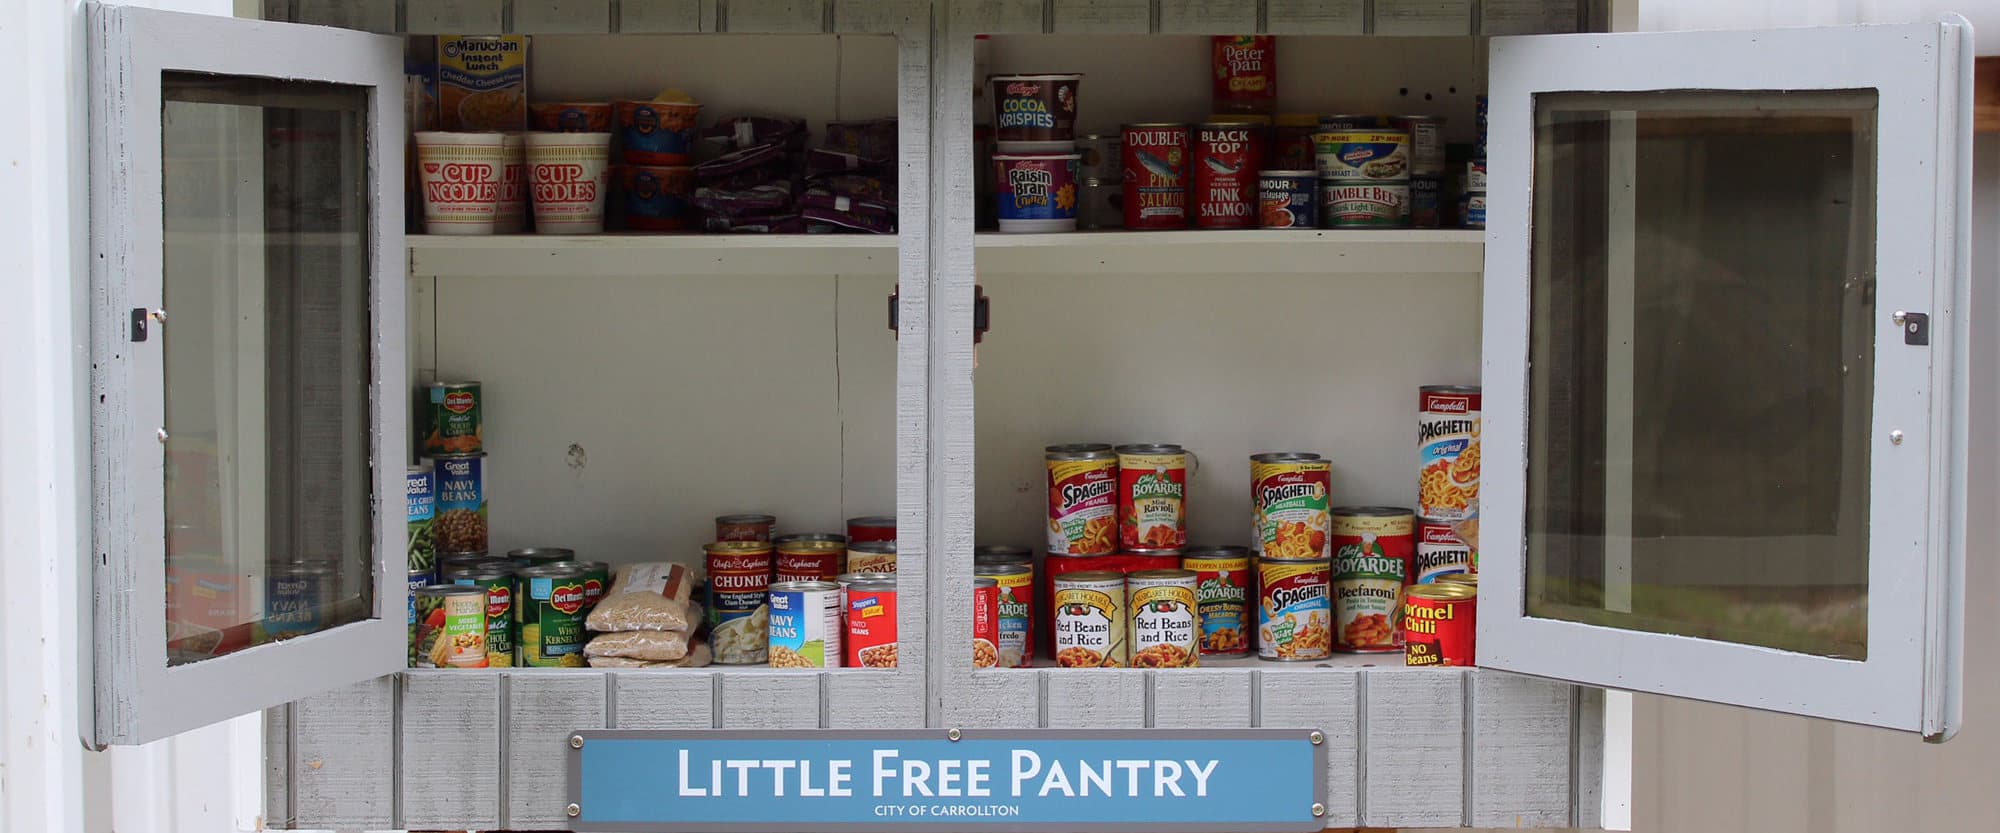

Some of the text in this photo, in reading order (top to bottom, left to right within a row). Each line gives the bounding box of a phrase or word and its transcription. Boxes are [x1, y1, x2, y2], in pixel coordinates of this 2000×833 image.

[457, 39, 518, 52] Maruchan
[461, 53, 503, 62] Instant
[1224, 45, 1265, 62] Peter
[465, 62, 499, 71] Lunch
[1227, 59, 1262, 76] Pan
[441, 70, 474, 86] Cheddar
[474, 74, 504, 88] Cheese
[1003, 98, 1047, 113] COCOA
[999, 112, 1055, 128] KRISPIES
[1129, 131, 1181, 146] DOUBLE
[1201, 131, 1248, 142] BLACK
[1208, 143, 1239, 154] TOP
[442, 163, 492, 184] CUP
[535, 163, 583, 184] CUP
[1010, 169, 1052, 185] Raisin
[1150, 173, 1178, 187] PINK
[428, 182, 499, 202] NOODLES
[1015, 183, 1047, 197] Bran
[1210, 188, 1241, 202] PINK
[1139, 191, 1185, 207] SALMON
[1200, 203, 1253, 217] SALMON
[444, 460, 470, 471] Great
[407, 476, 428, 488] reat
[444, 480, 475, 492] NAVY
[441, 490, 478, 502] BEANS
[1132, 482, 1184, 499] BOYARDEE
[408, 505, 429, 516] EANS
[1144, 503, 1176, 514] Ravioli
[1337, 544, 1361, 559] Chef
[788, 558, 823, 571] Cupboard
[1331, 557, 1406, 577] BOYARDEE
[714, 574, 769, 588] CHUNKY
[554, 593, 566, 603] Del
[770, 594, 789, 604] Great
[1197, 587, 1246, 602] BOYARDEE
[1337, 584, 1396, 601] Beefaroni
[998, 604, 1030, 619] ARDEE
[1405, 603, 1454, 621] ormel
[1056, 619, 1108, 633] Red Beans
[1137, 617, 1192, 631] Red Beans
[1405, 616, 1437, 634] Chili
[544, 635, 574, 646] KERNEL
[1077, 633, 1103, 646] Rice
[1140, 630, 1189, 643] and Rice
[1411, 643, 1428, 656] NO
[1407, 653, 1438, 666] Beans
[679, 749, 1220, 798] LITTLE FREE PANTRY
[874, 804, 1019, 817] CITY OF CARROLLTON
